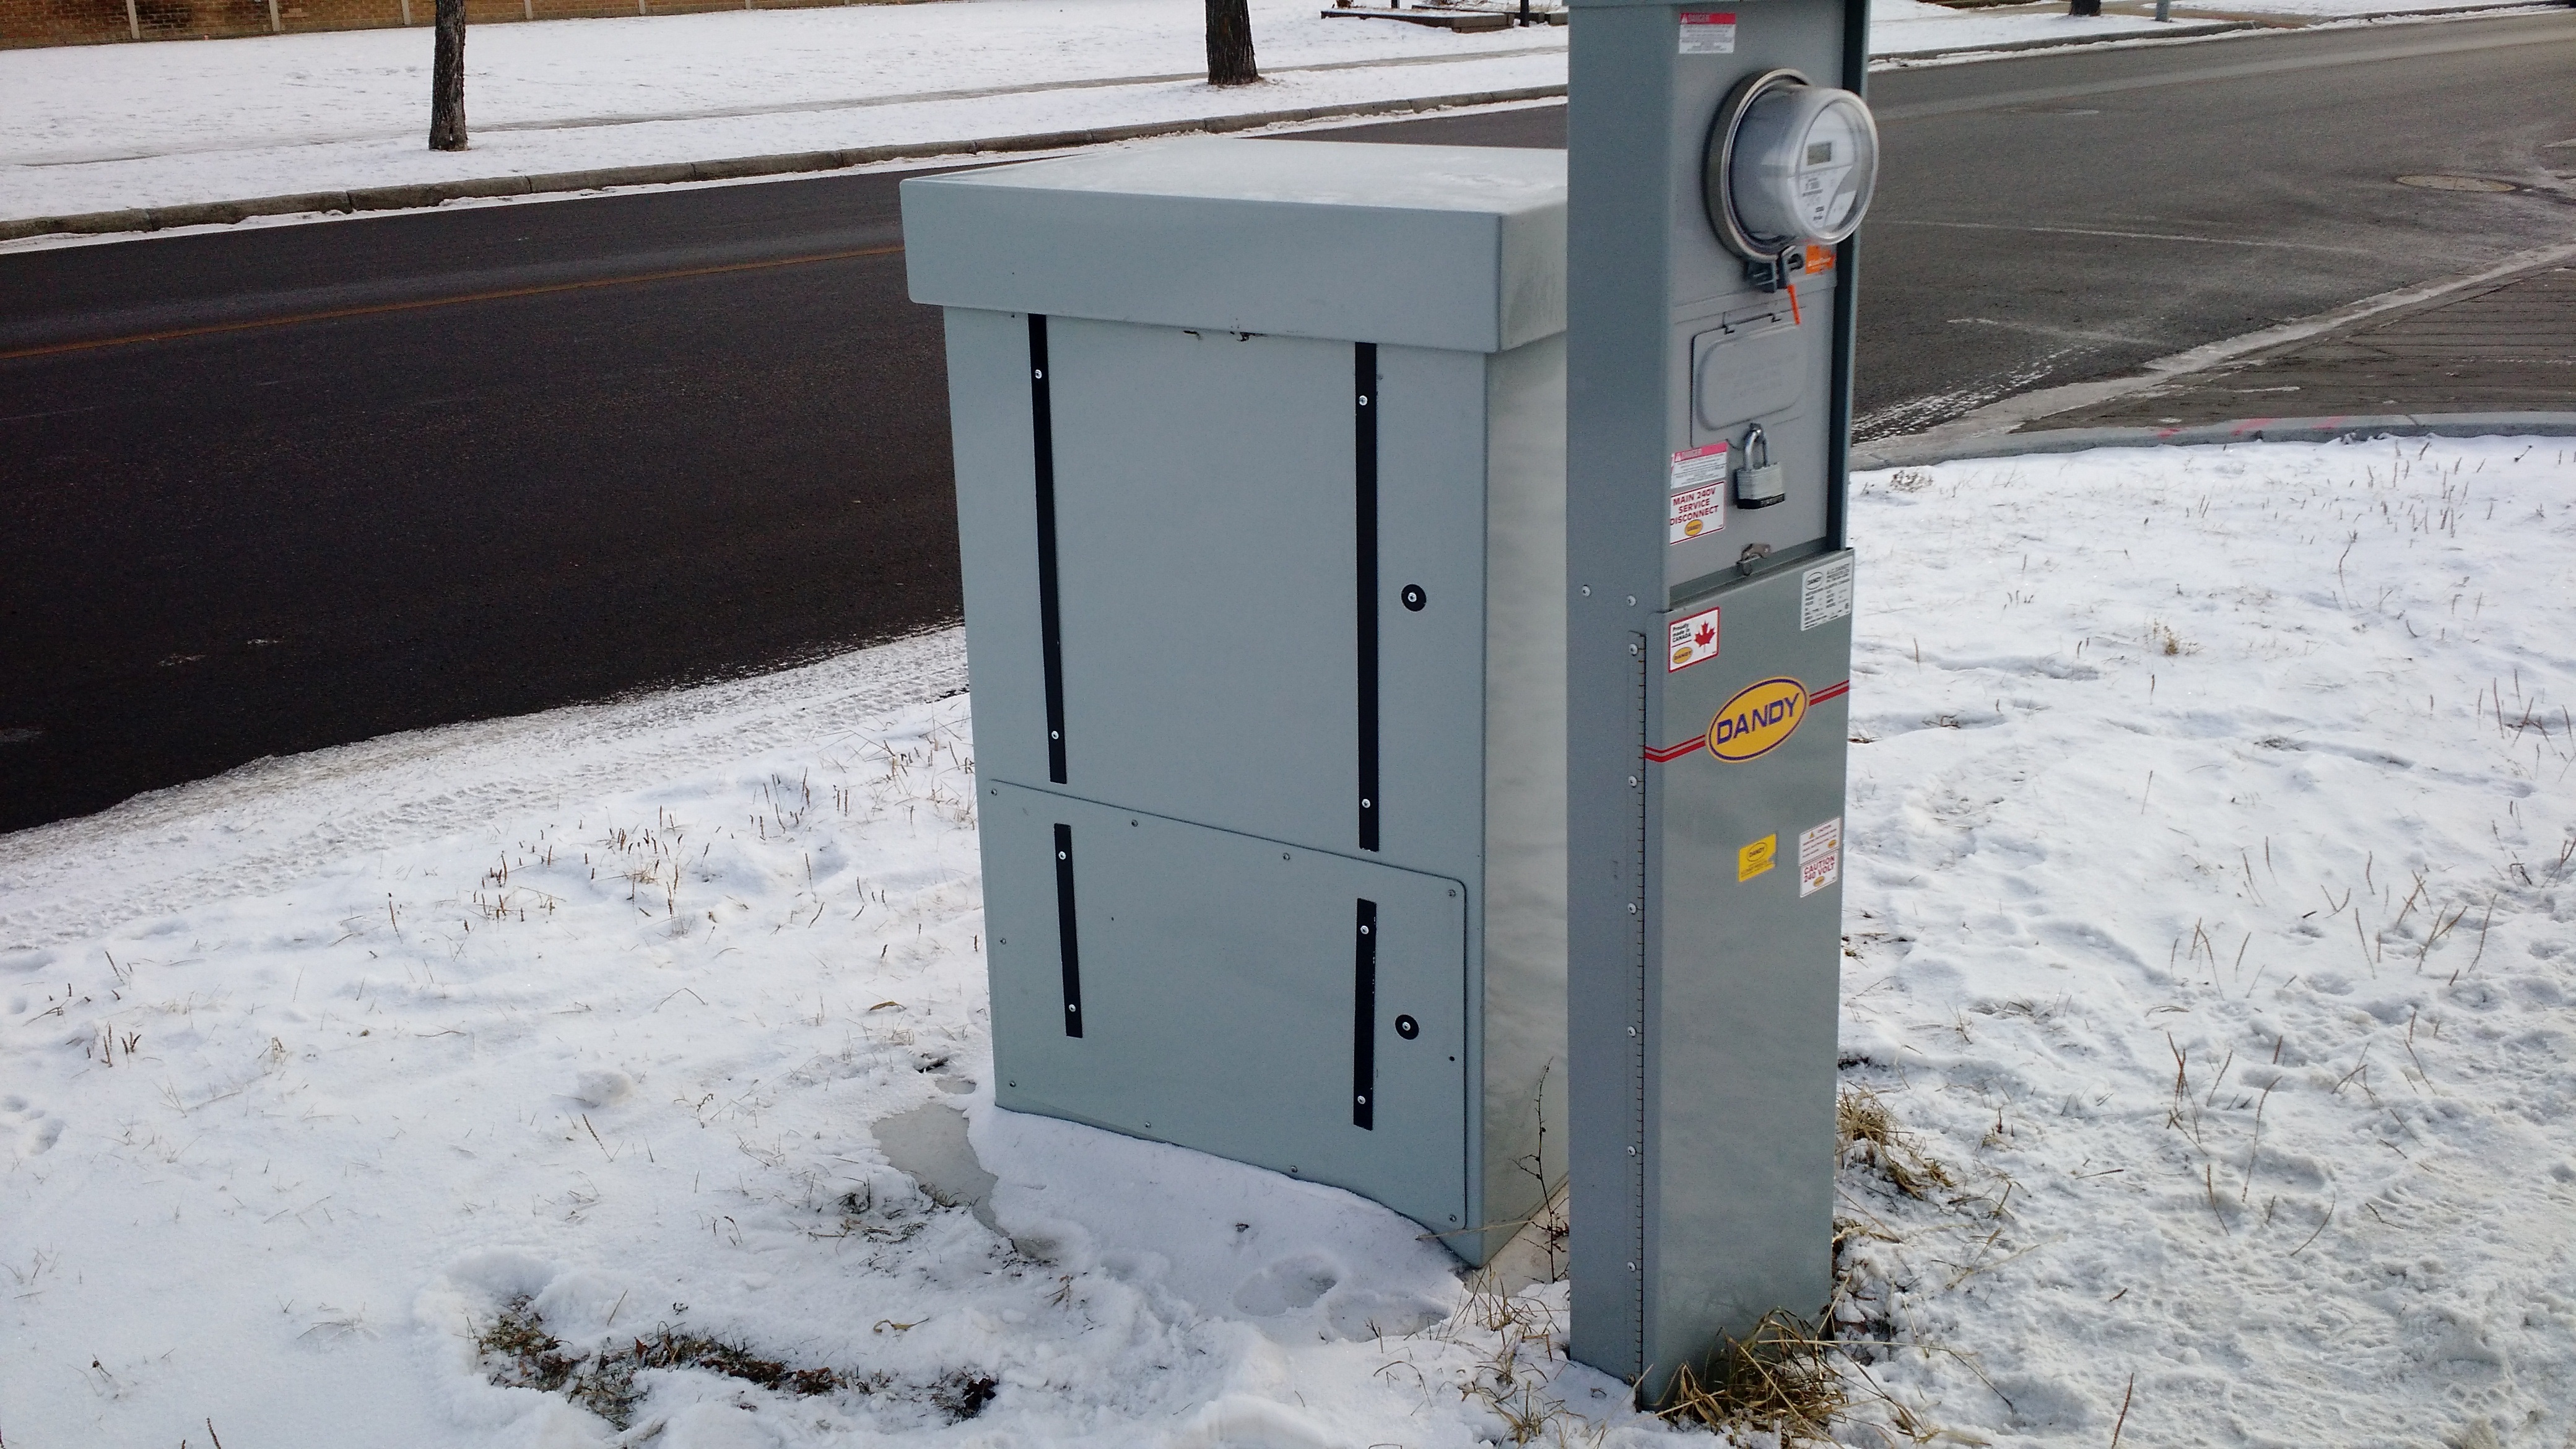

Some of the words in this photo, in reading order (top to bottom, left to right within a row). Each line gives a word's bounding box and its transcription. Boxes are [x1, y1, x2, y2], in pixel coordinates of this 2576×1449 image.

[1673, 494, 1694, 506] MAIN
[1697, 487, 1716, 499] 240V
[1679, 498, 1710, 514] SERVICE
[1670, 505, 1718, 526] DISCONNECT
[1673, 623, 1689, 632] Proudly
[1673, 632, 1691, 643] CANADA
[1717, 692, 1799, 746] DANDY
[1804, 855, 1834, 874] CAUTION
[1804, 871, 1816, 883] 240
[1818, 863, 1834, 874] VOLT
